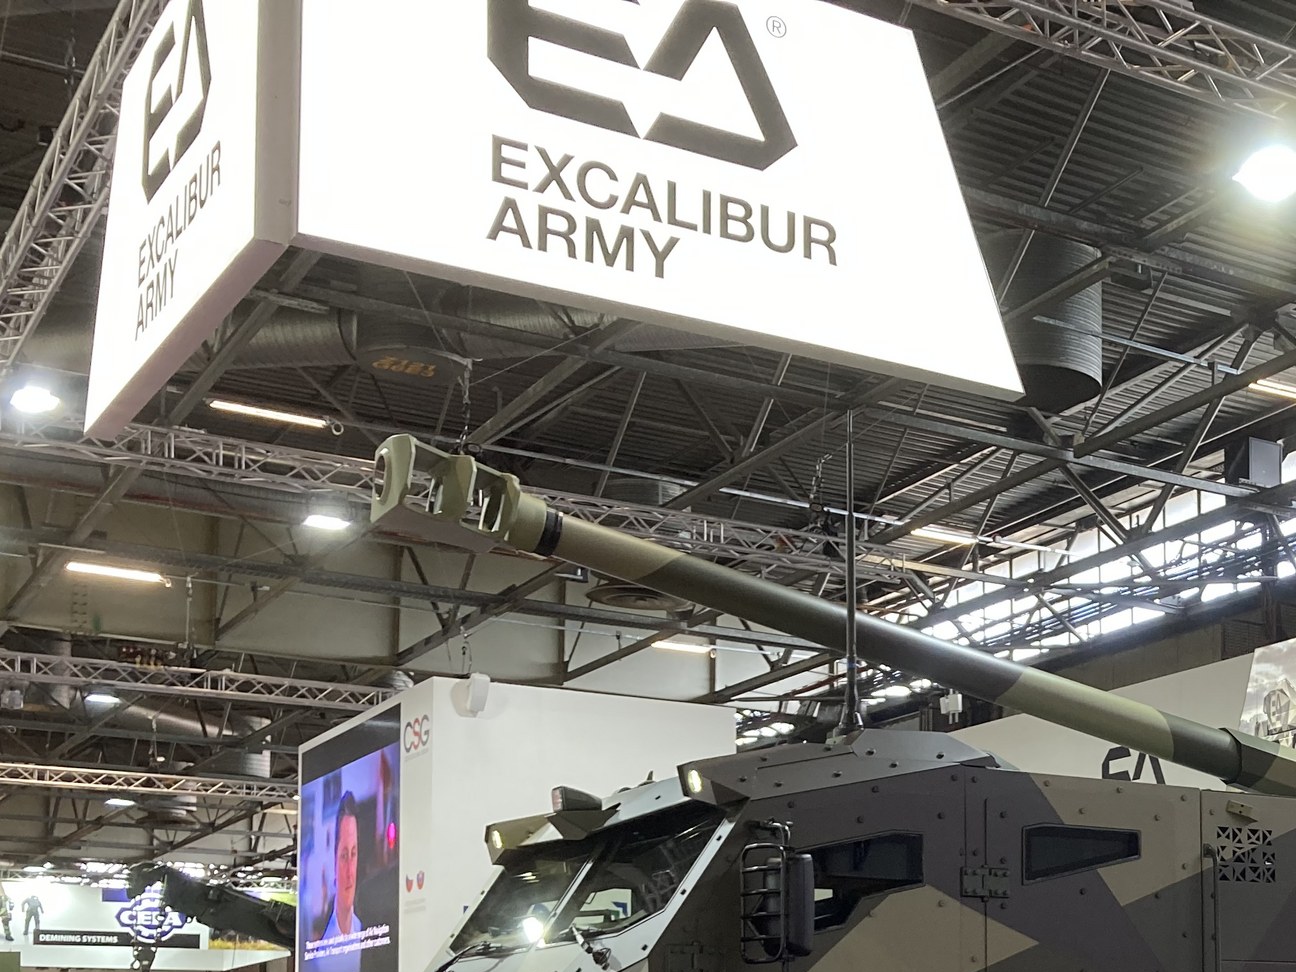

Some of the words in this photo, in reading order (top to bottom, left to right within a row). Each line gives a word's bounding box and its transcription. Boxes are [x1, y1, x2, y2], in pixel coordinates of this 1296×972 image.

[137, 140, 221, 288] EXCALIBUR
[486, 196, 681, 279] ARMY
[492, 133, 838, 267] EXCALIBUR
[135, 248, 178, 341] ARMY
[403, 714, 430, 753] CSG
[39, 934, 82, 943] DEMINING
[82, 935, 118, 944] SYSTEMS
